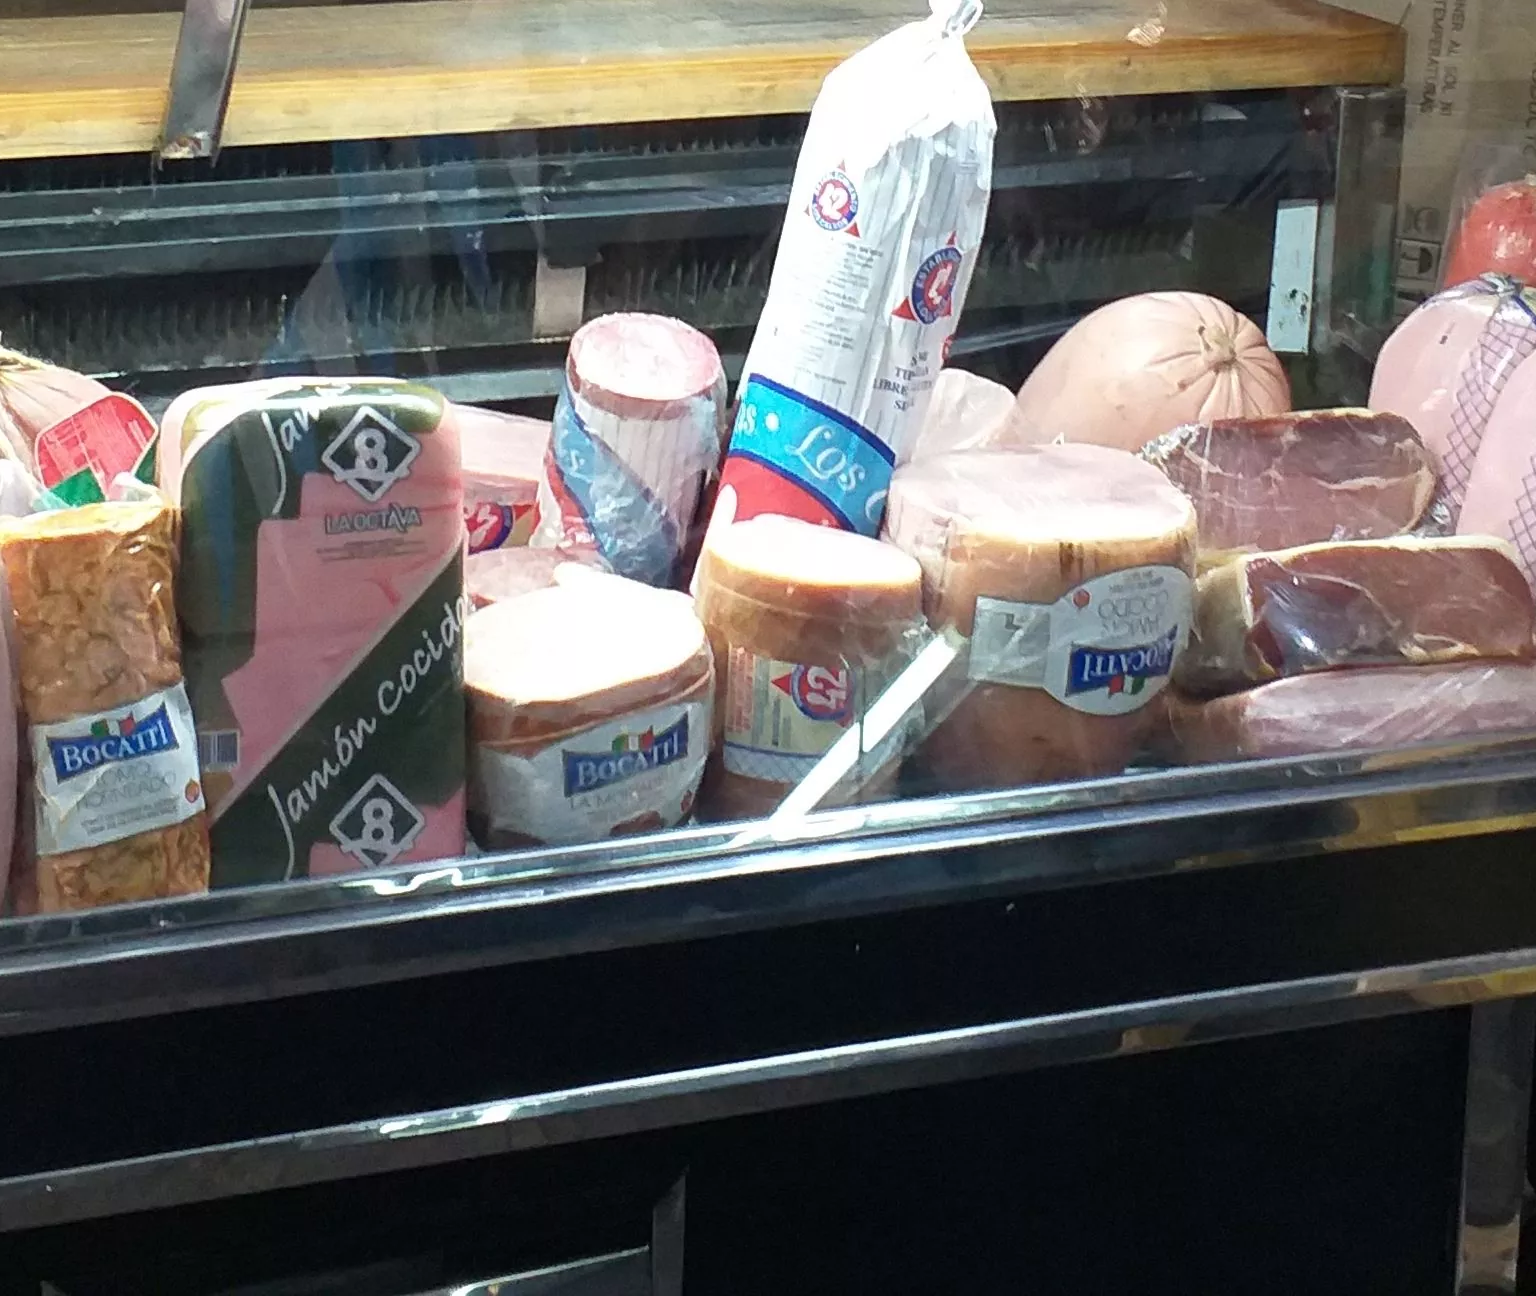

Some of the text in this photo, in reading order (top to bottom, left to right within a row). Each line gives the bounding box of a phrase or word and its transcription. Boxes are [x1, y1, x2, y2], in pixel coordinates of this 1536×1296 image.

[785, 422, 866, 494] Los
[325, 503, 422, 534] LA OCTAVA
[62, 719, 170, 773] BOCATTI
[267, 595, 469, 882] Jamón cocido
[577, 733, 682, 786] BOCATTI
